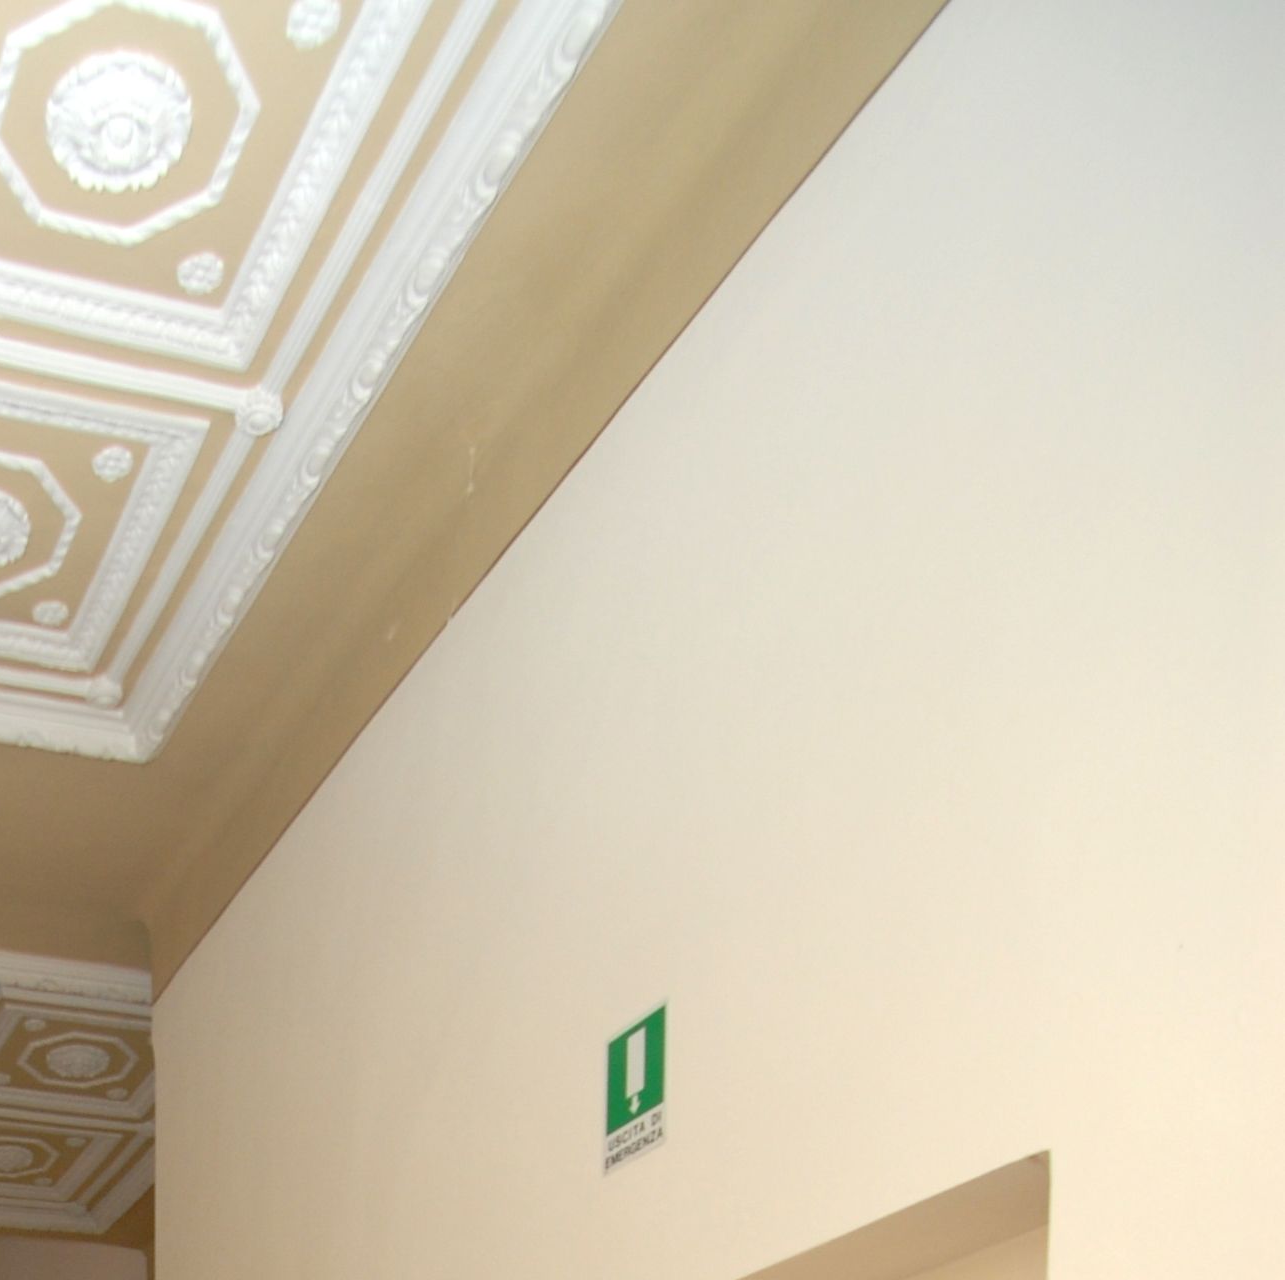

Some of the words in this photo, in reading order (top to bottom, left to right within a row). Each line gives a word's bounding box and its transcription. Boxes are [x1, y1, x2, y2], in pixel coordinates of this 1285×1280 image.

[605, 1127, 663, 1169] EMERGENZA
[608, 1121, 645, 1151] USCITA
[651, 1110, 662, 1126] DI
